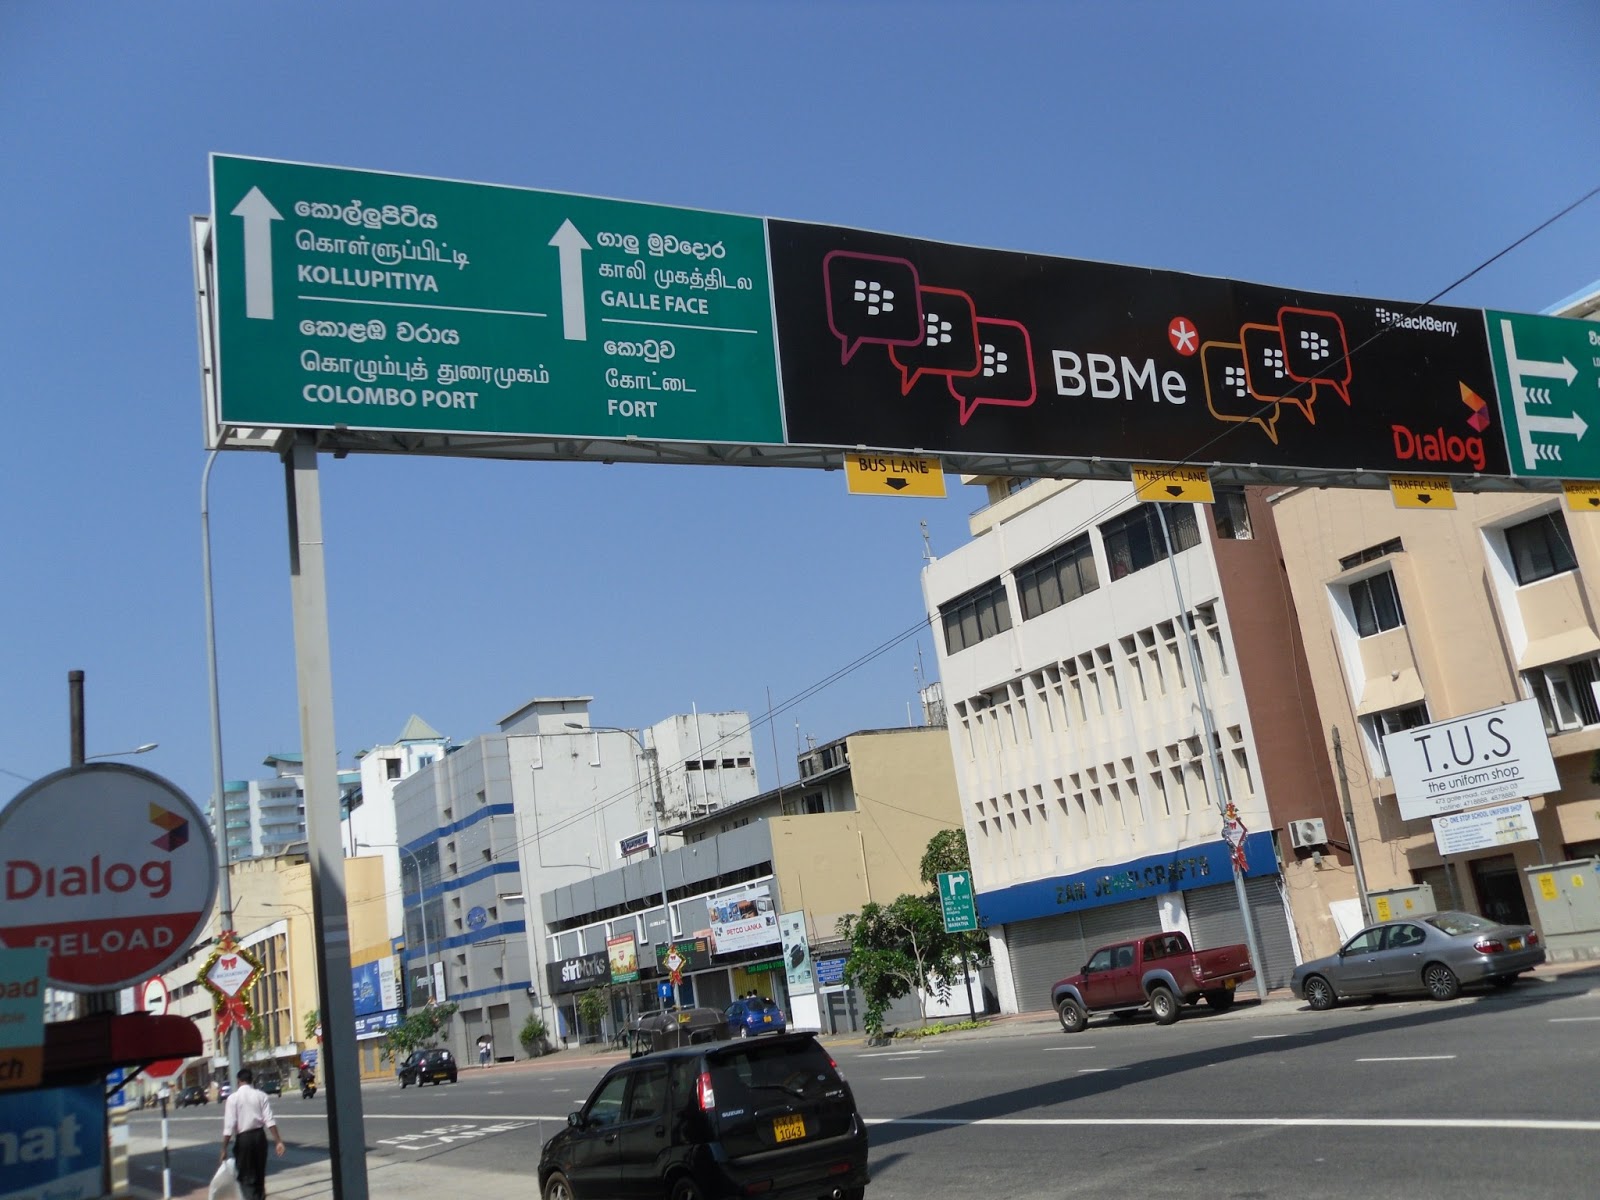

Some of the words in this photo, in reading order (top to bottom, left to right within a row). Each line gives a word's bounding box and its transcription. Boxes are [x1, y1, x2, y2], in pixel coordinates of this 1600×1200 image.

[295, 229, 470, 270] கொள்ளுப்பிட்டி
[596, 231, 640, 255] ගාලු
[297, 264, 439, 293] KOLLUPITIYA
[598, 259, 647, 281] காலி
[600, 290, 661, 311] GALLE
[664, 295, 709, 315] FACE
[396, 321, 460, 345] වරාය
[1392, 312, 1457, 337] BlackBerry
[603, 339, 676, 363] කොටුව
[300, 349, 429, 382] கொழும்புத்
[1051, 349, 1187, 405] BBMe
[605, 367, 697, 392] கோட்டை
[302, 384, 417, 407] COLOMBO
[421, 389, 479, 410] PORT
[607, 399, 658, 418] FORT
[1391, 424, 1486, 471] Dialog
[859, 457, 889, 473] BUS
[892, 458, 929, 474] LANE
[1134, 469, 1179, 482] TRAFFIC
[1180, 470, 1206, 483] LANE
[1392, 479, 1428, 490] TRAFFIC
[1429, 481, 1450, 491] LANE
[1414, 717, 1511, 773] T.U.S
[1428, 782, 1447, 793] the
[1449, 771, 1490, 789] uniform
[1492, 765, 1520, 783] shop
[1480, 785, 1509, 796] colombo
[1472, 811, 1489, 821] SCHOOL
[1511, 804, 1522, 812] SHOP
[5, 854, 172, 901] Dialog
[744, 923, 762, 932] LANKA
[780, 1126, 802, 1141] 1043
